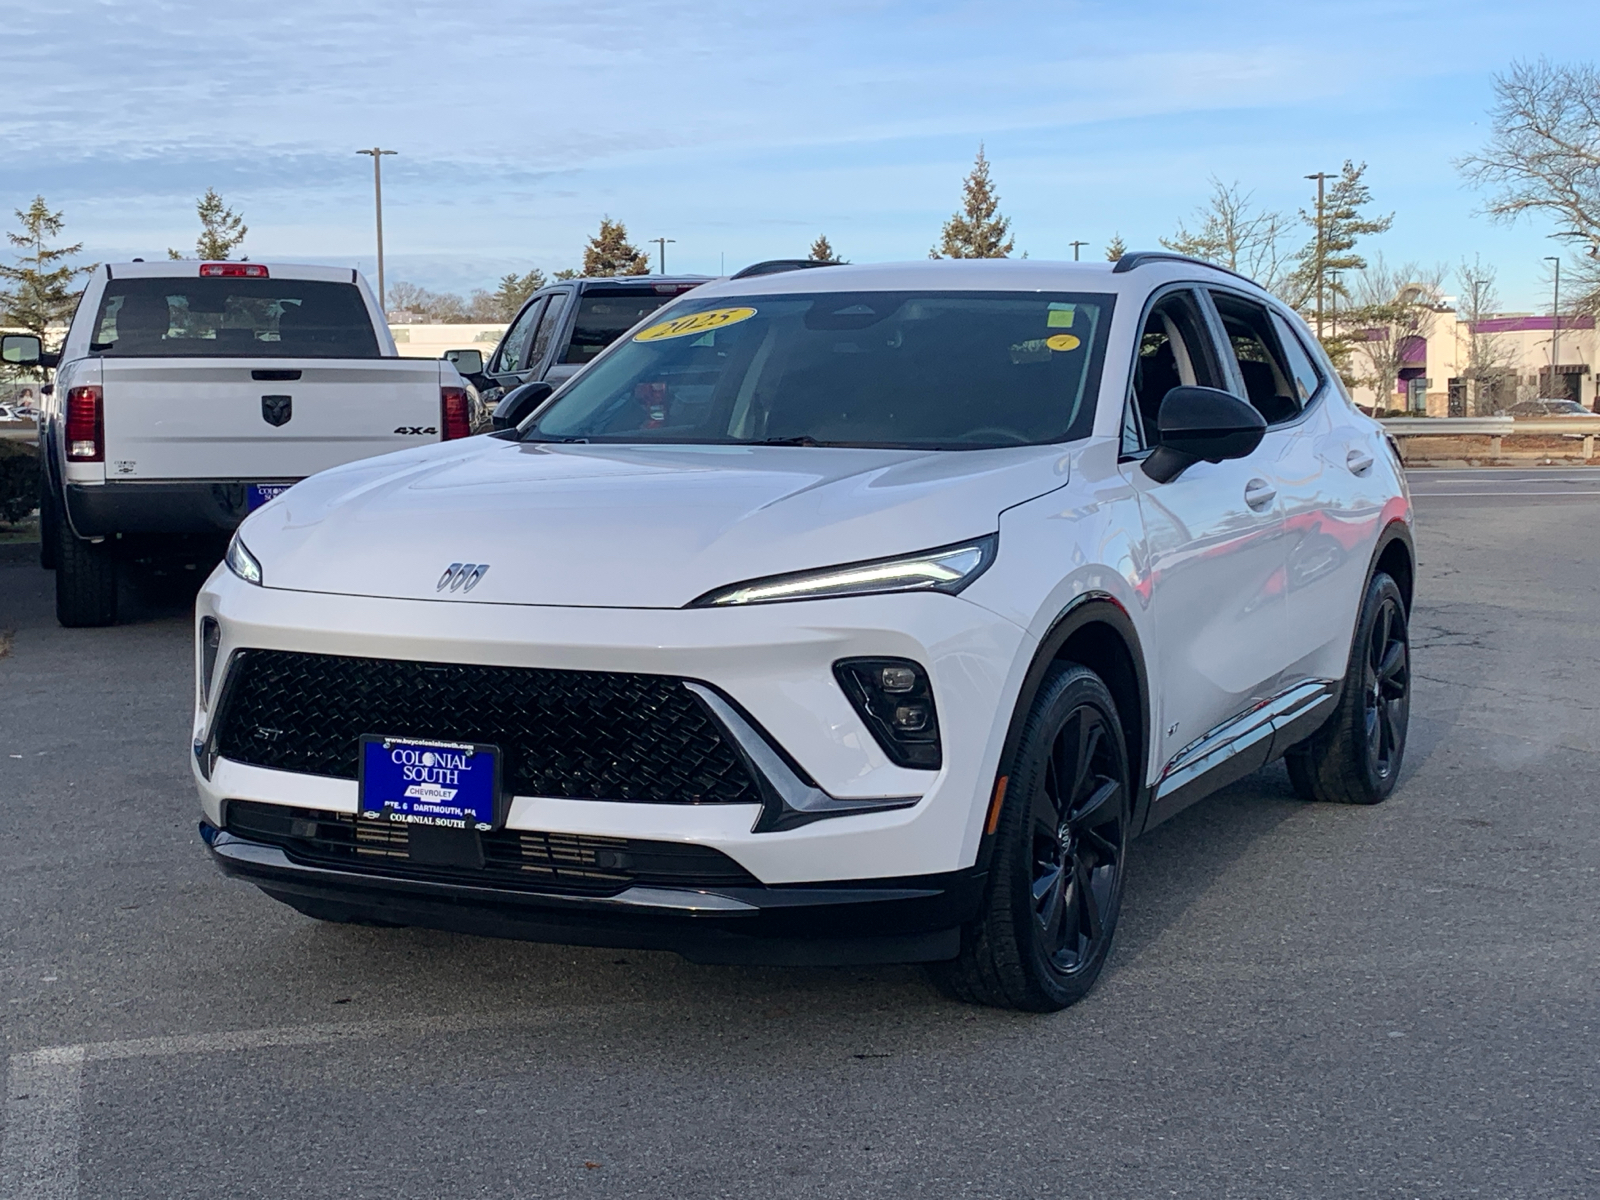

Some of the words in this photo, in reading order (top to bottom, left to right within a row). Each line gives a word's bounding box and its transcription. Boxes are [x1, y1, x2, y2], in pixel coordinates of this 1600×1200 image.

[650, 308, 740, 338] 2025
[393, 426, 438, 435] 4X4
[384, 737, 474, 750] www.buycolonialsouth.com
[391, 749, 472, 771] COLONIAL
[403, 766, 459, 785] SOUTH
[409, 787, 452, 798] CHEVROLET
[402, 802, 408, 810] 6
[413, 804, 463, 816] DARTMOUTH,
[390, 813, 434, 825] COLONIAL
[435, 818, 465, 828] SOUTH
